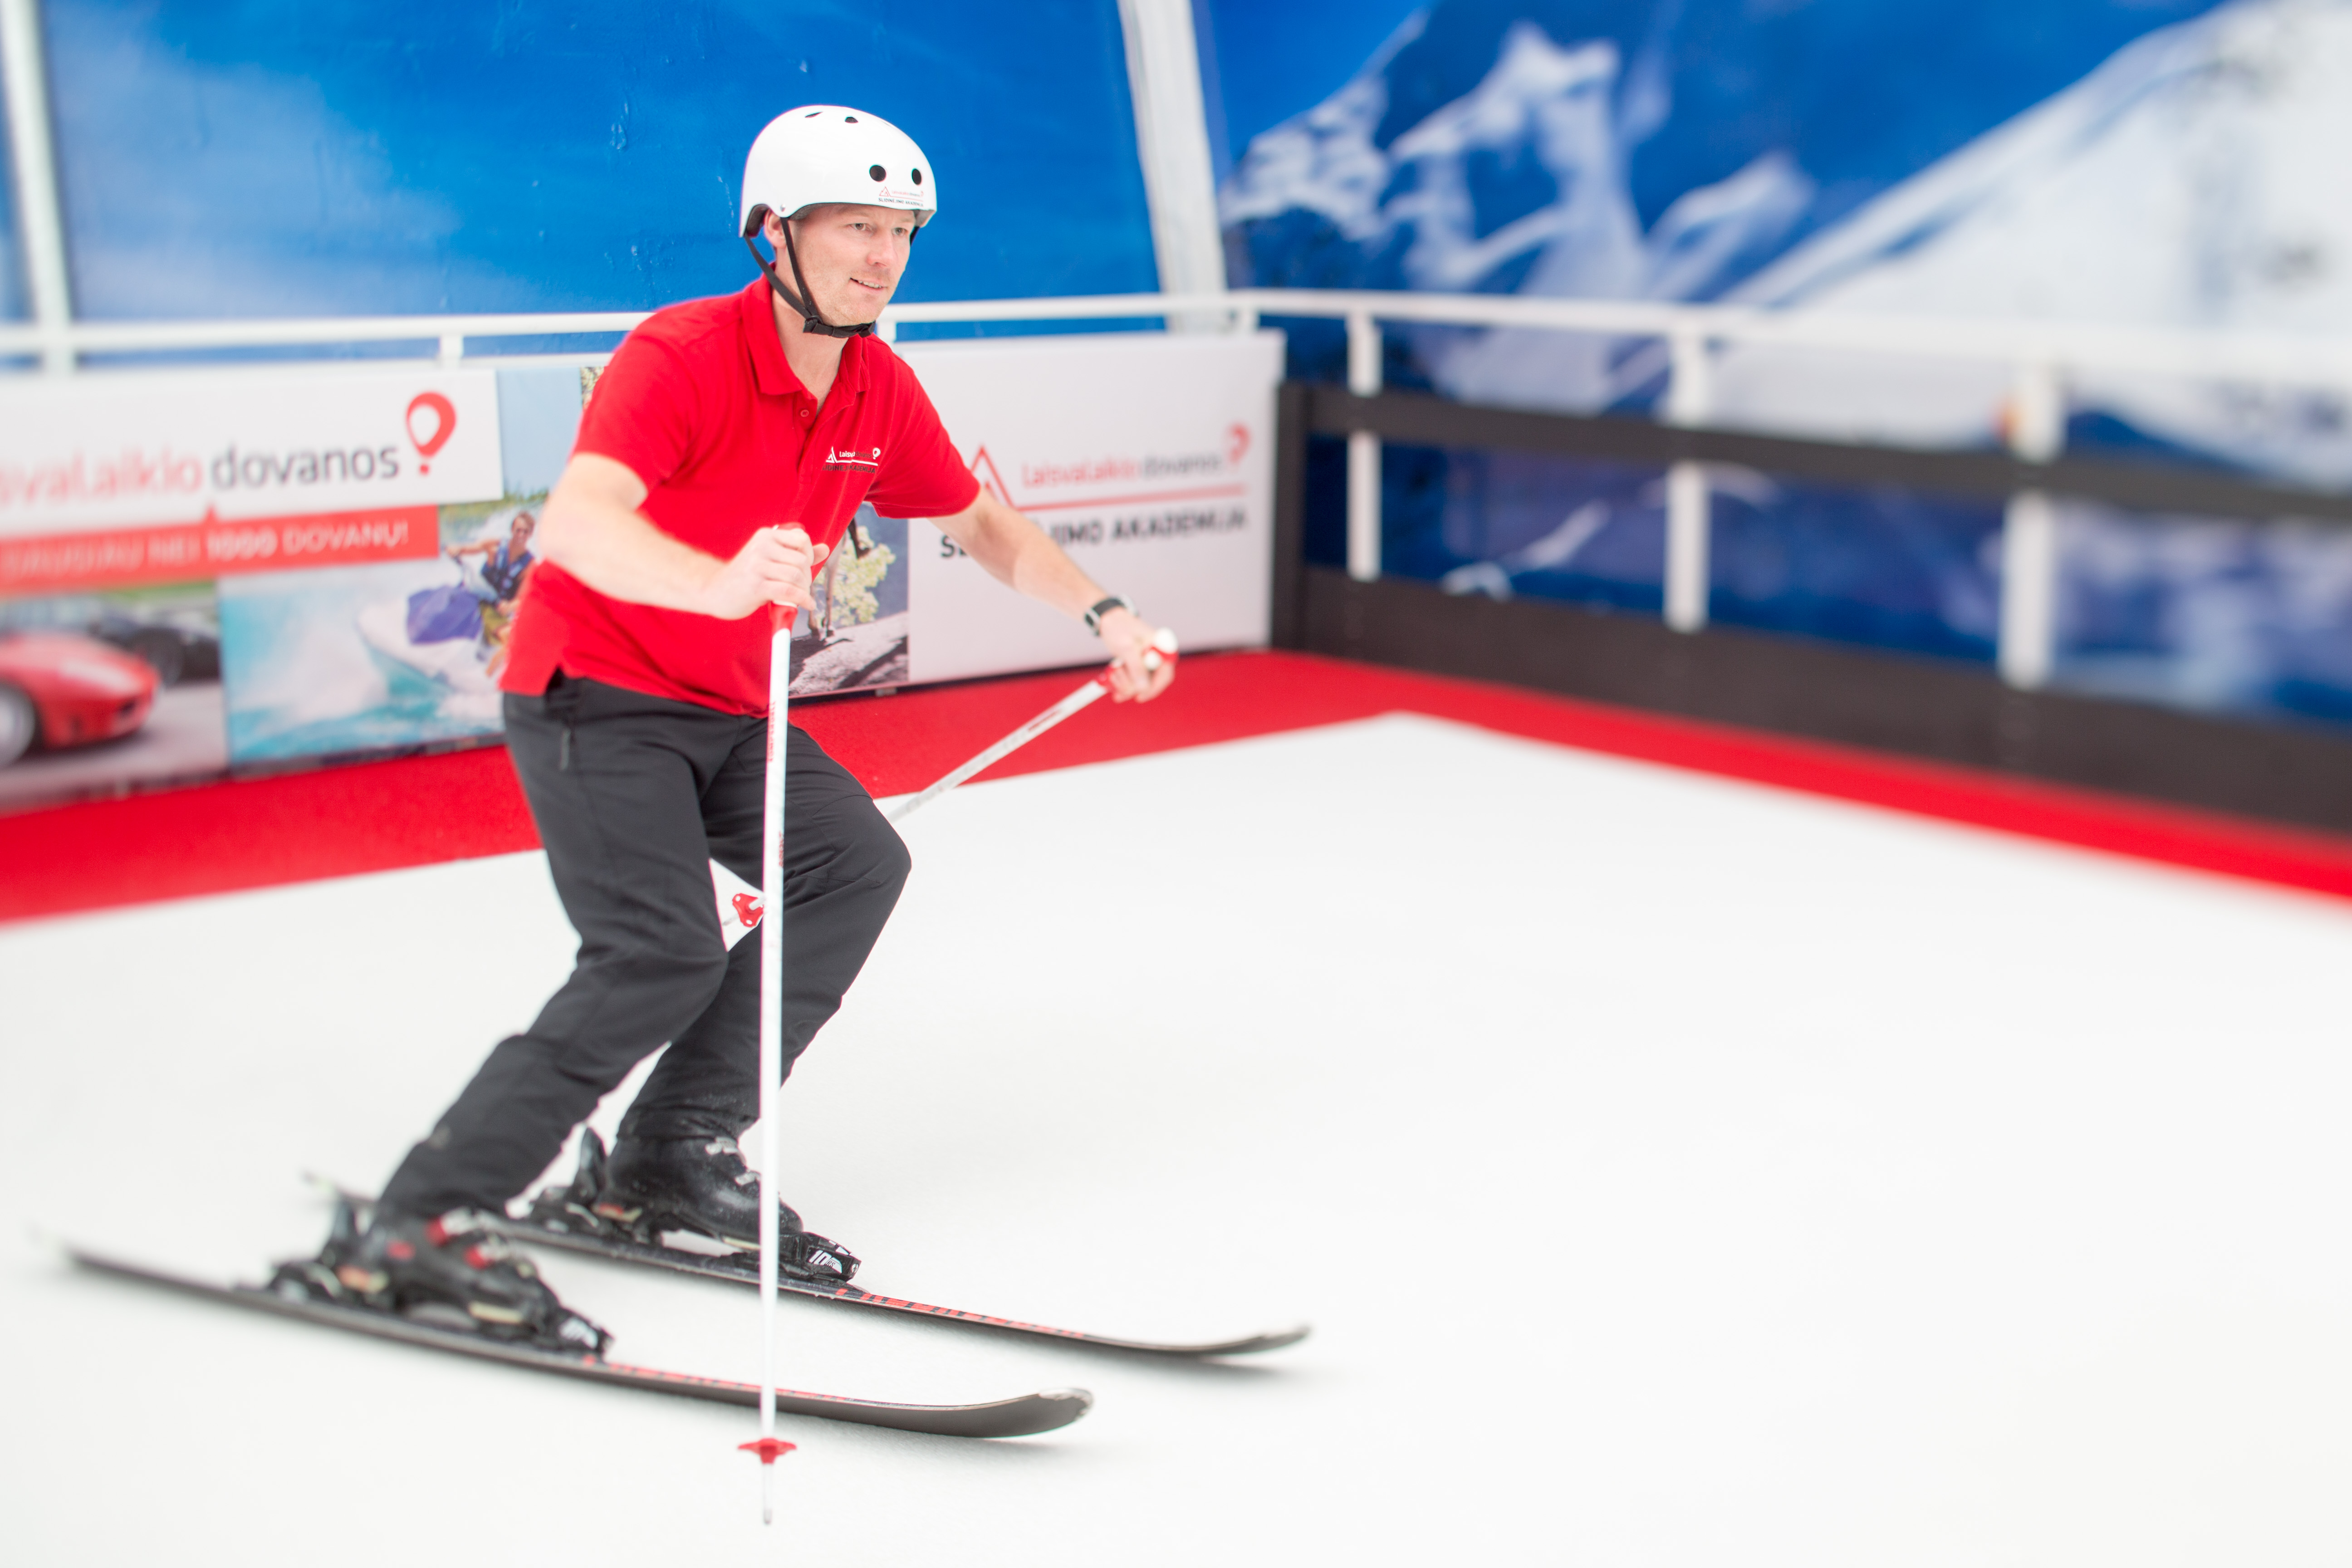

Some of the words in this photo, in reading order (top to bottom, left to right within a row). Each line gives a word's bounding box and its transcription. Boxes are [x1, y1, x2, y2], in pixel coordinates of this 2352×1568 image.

[211, 445, 399, 491] dovanos
[207, 526, 278, 562] 1000
[808, 1250, 832, 1266] 10
